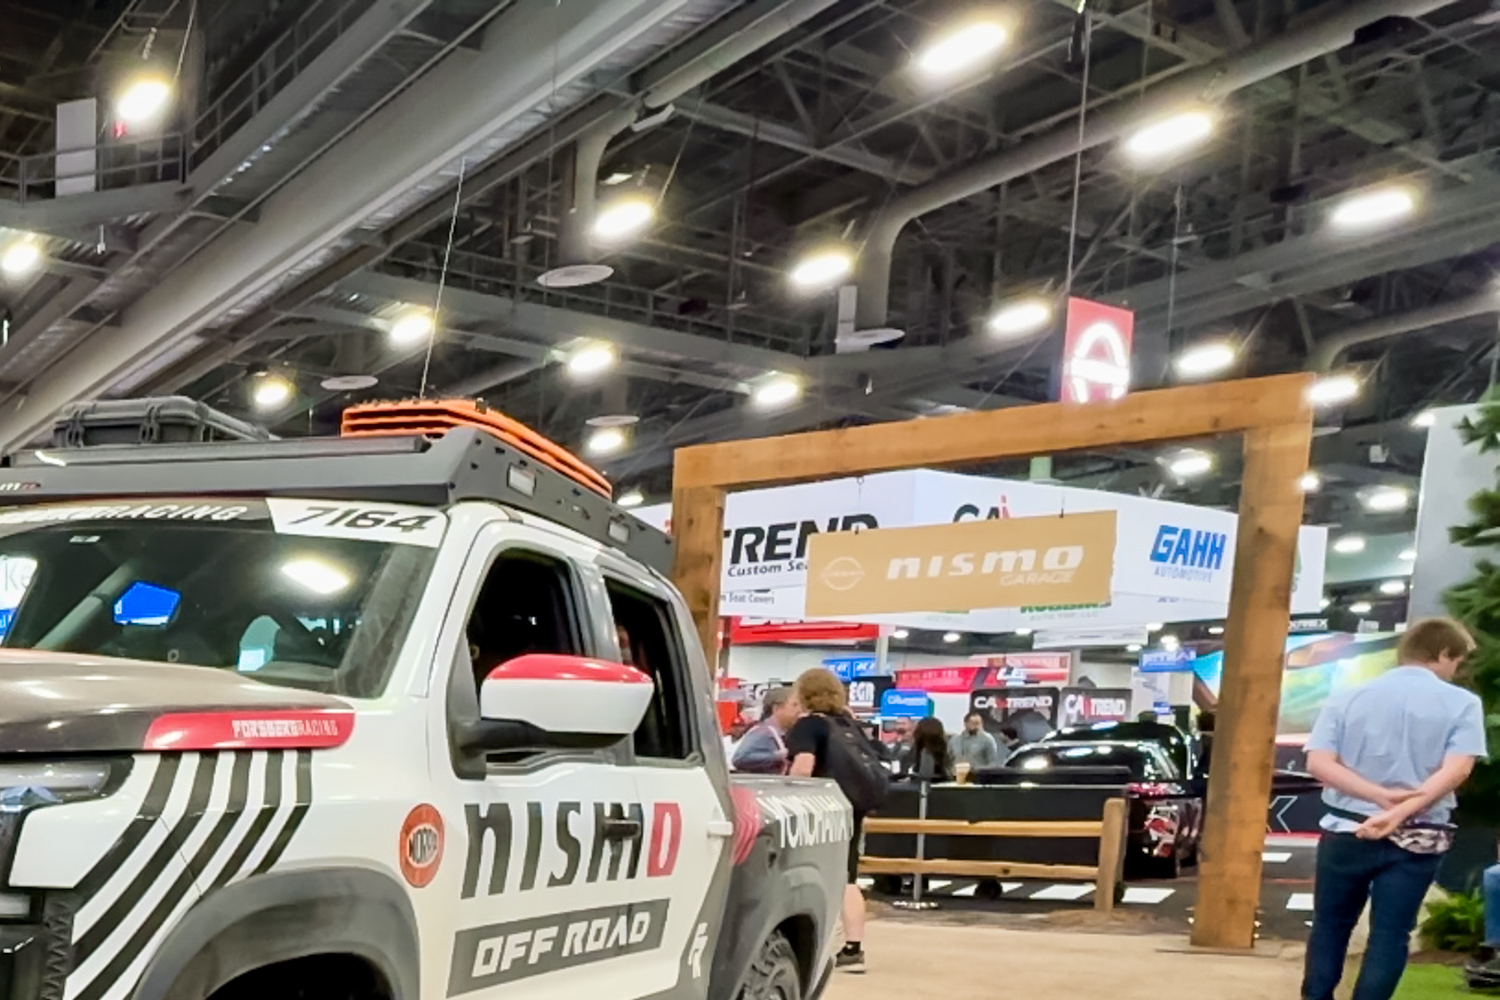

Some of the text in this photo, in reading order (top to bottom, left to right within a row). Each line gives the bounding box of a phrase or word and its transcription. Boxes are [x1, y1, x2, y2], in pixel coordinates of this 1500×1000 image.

[290, 506, 437, 533] 7164
[1150, 524, 1227, 570] GAHH
[727, 563, 782, 578] Custom
[1000, 570, 1076, 586] GARAGE
[1154, 566, 1214, 584] AUTOMOTIVE
[471, 911, 651, 978] OFF ROAD
